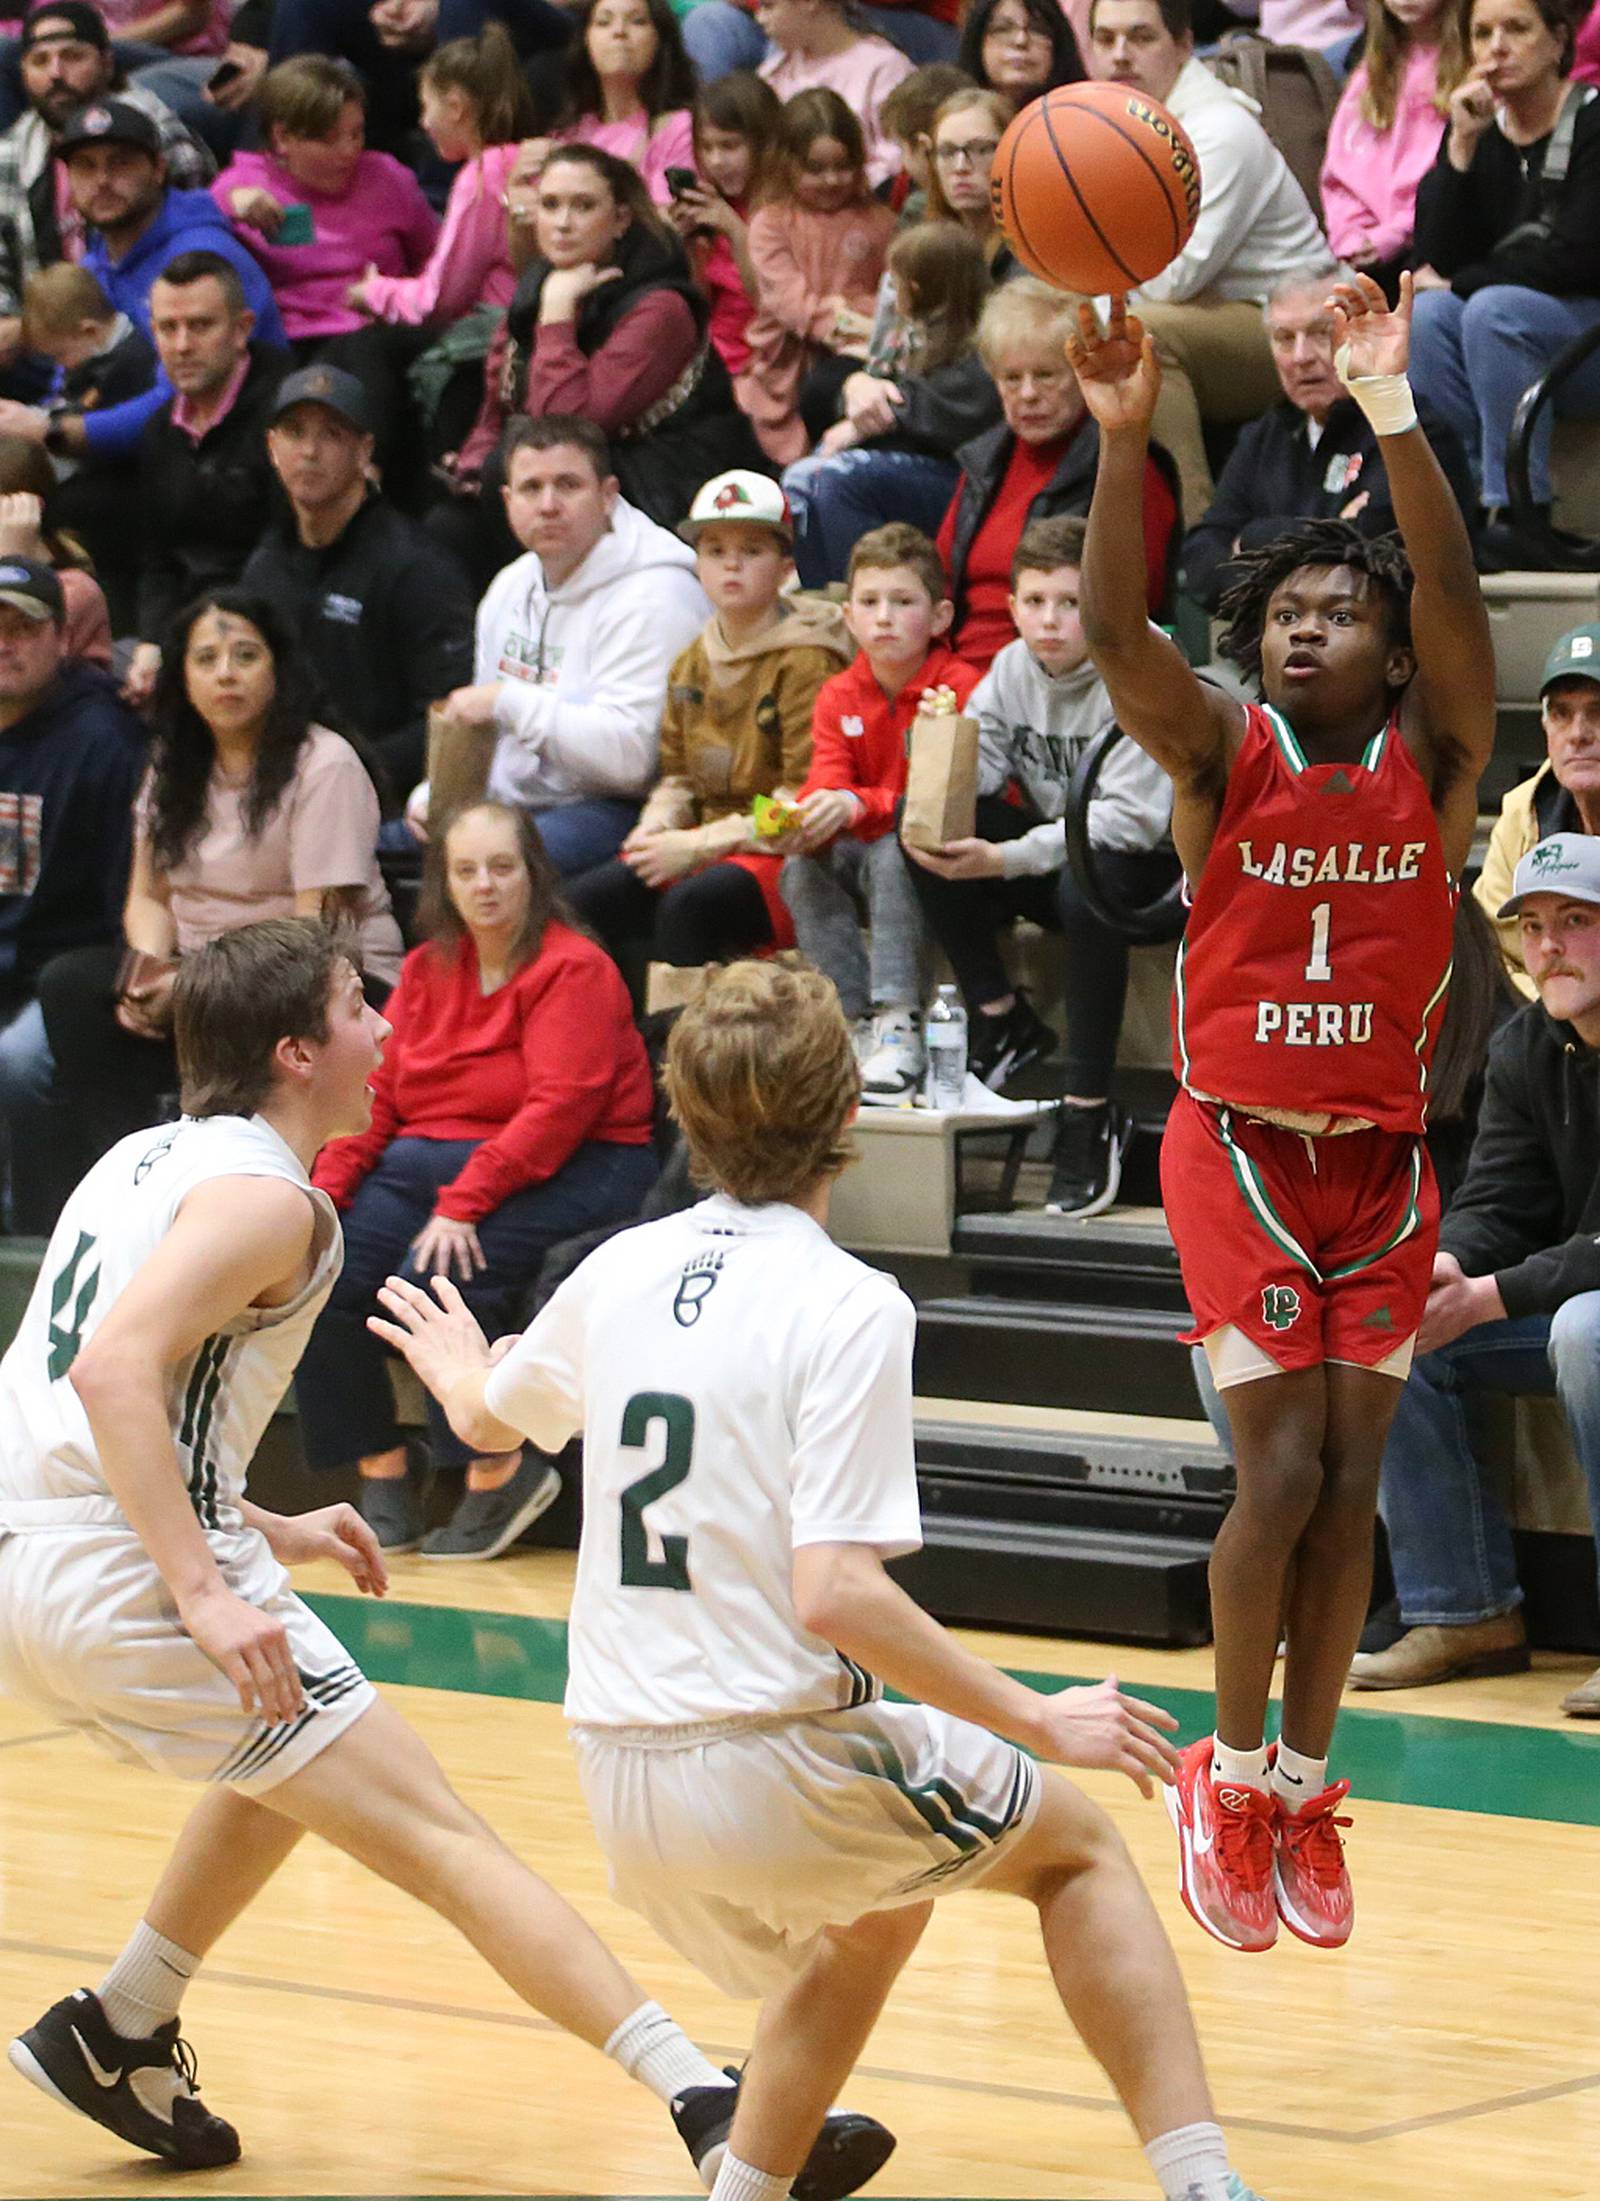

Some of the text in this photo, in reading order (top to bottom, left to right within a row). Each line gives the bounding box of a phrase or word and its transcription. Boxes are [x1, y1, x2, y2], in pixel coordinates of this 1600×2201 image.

[1237, 840, 1427, 888] LASALLE
[1304, 902, 1332, 981] 1
[1254, 1000, 1375, 1046] PERU
[619, 1390, 696, 1592] 2
